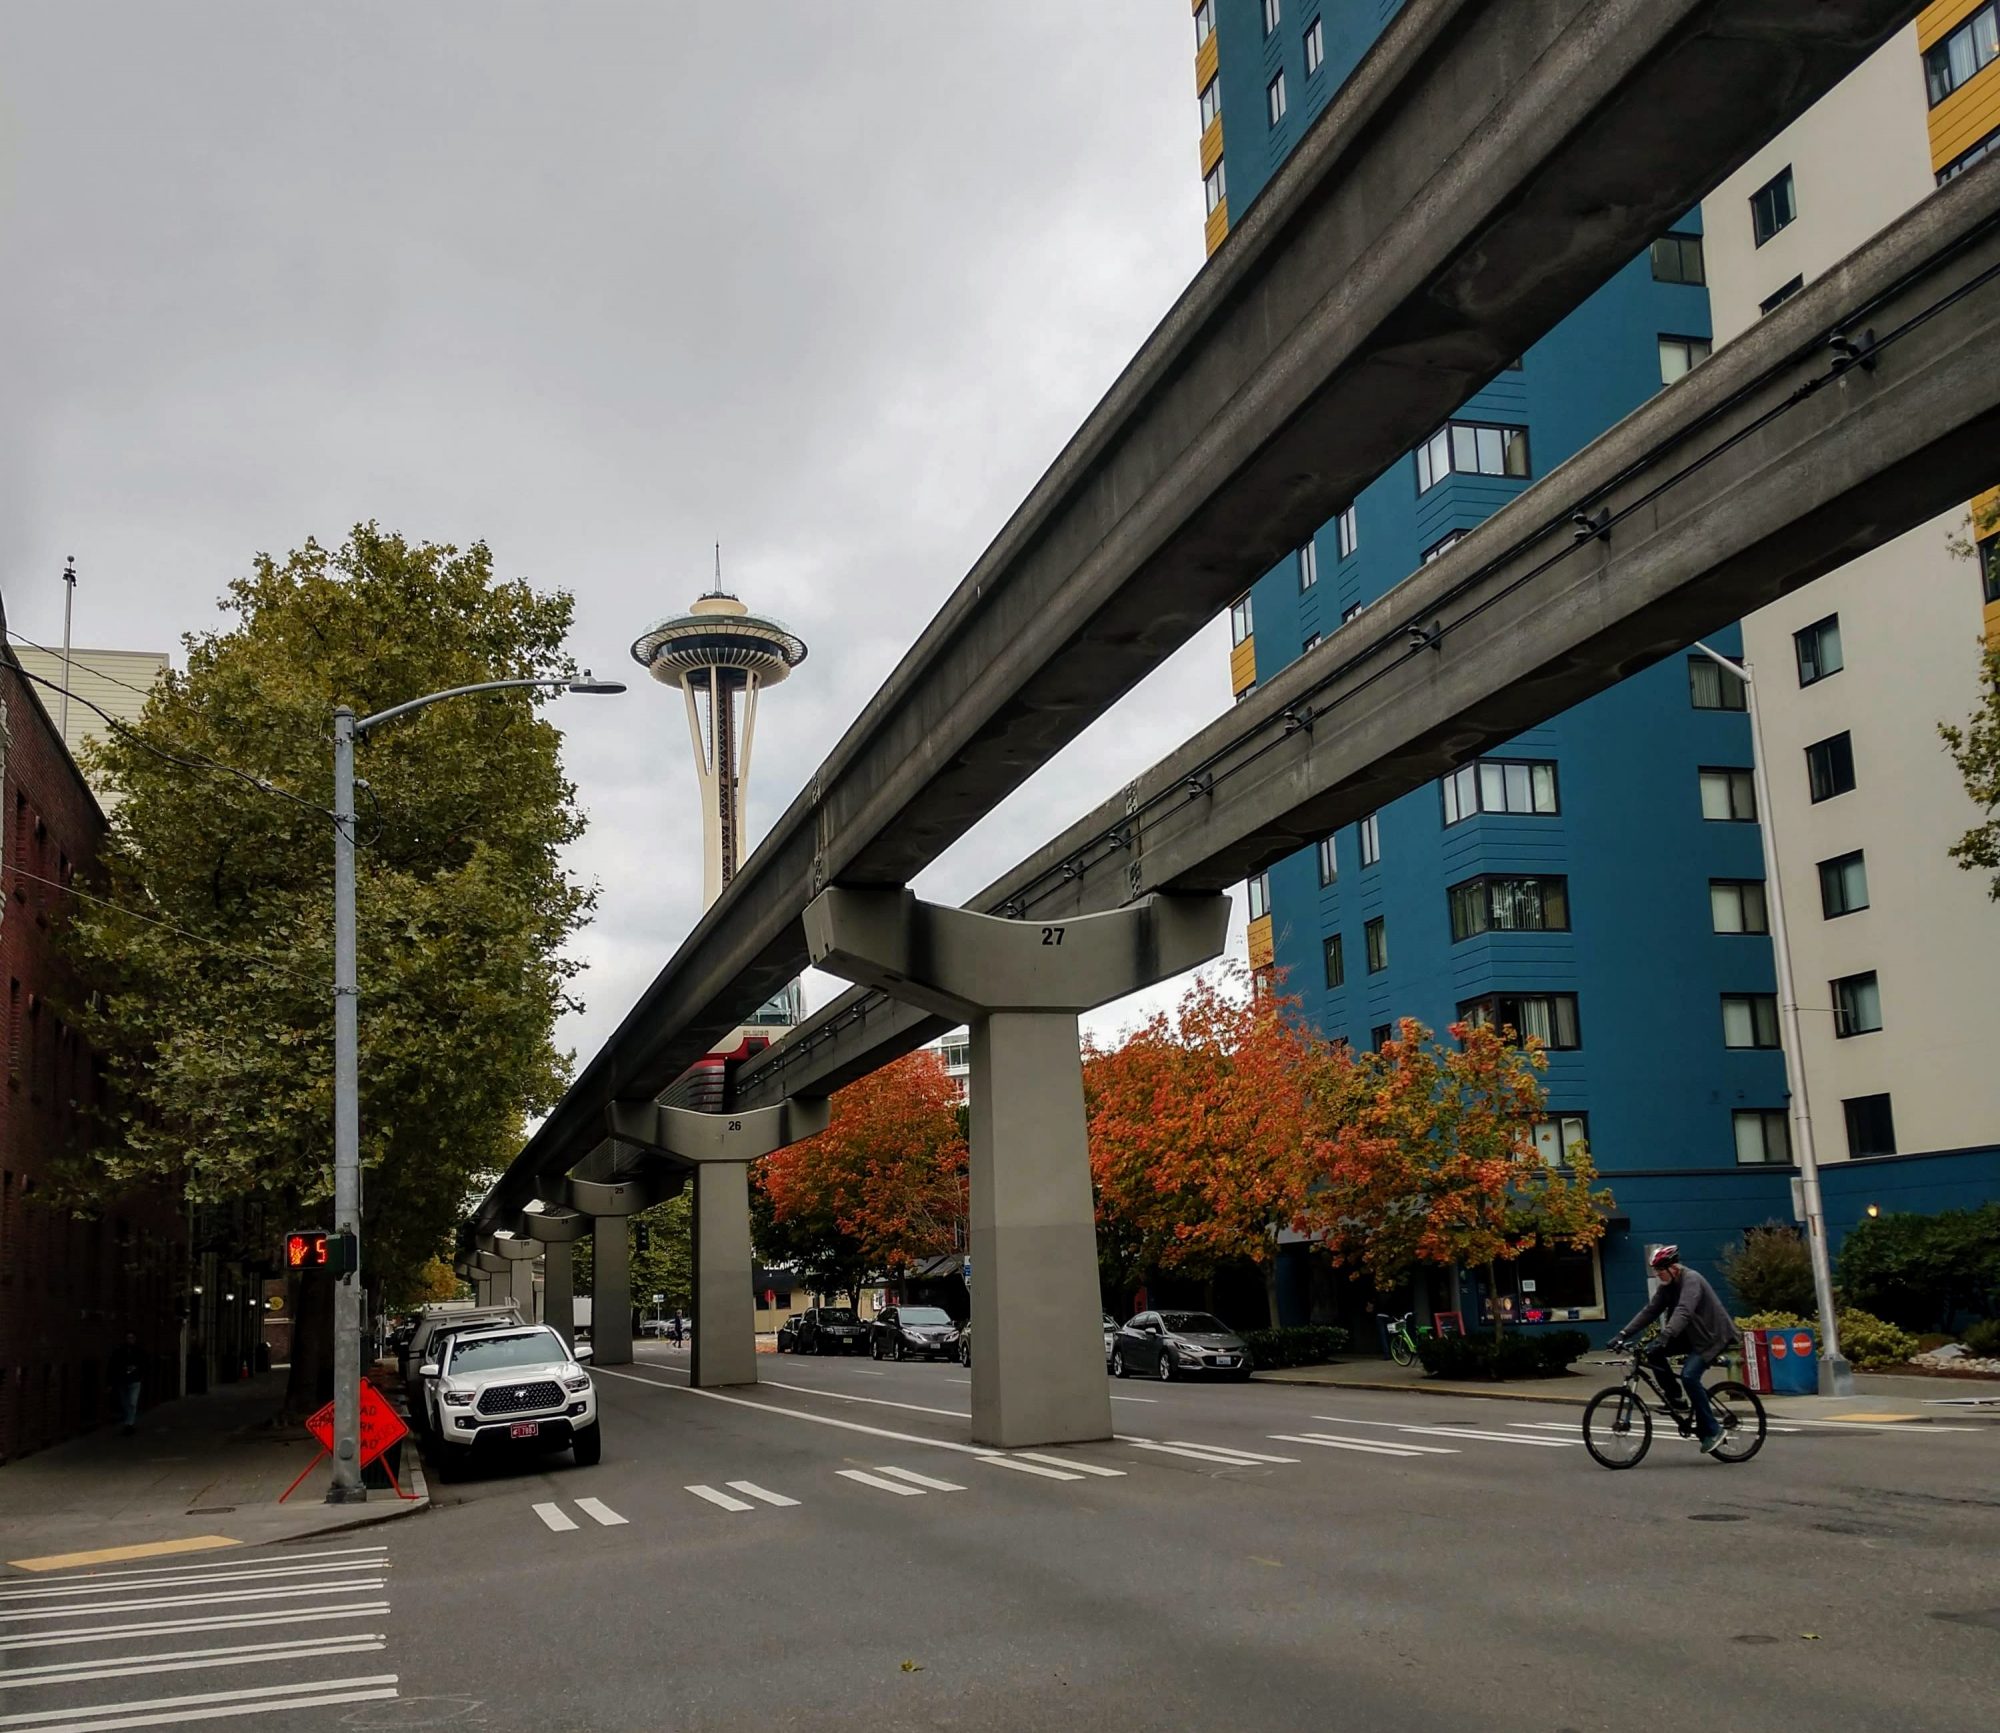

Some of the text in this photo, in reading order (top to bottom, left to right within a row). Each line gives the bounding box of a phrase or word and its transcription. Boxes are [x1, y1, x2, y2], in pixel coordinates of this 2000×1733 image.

[1041, 927, 1065, 945] 27
[728, 1120, 742, 1131] 26
[316, 1239, 326, 1263] 5
